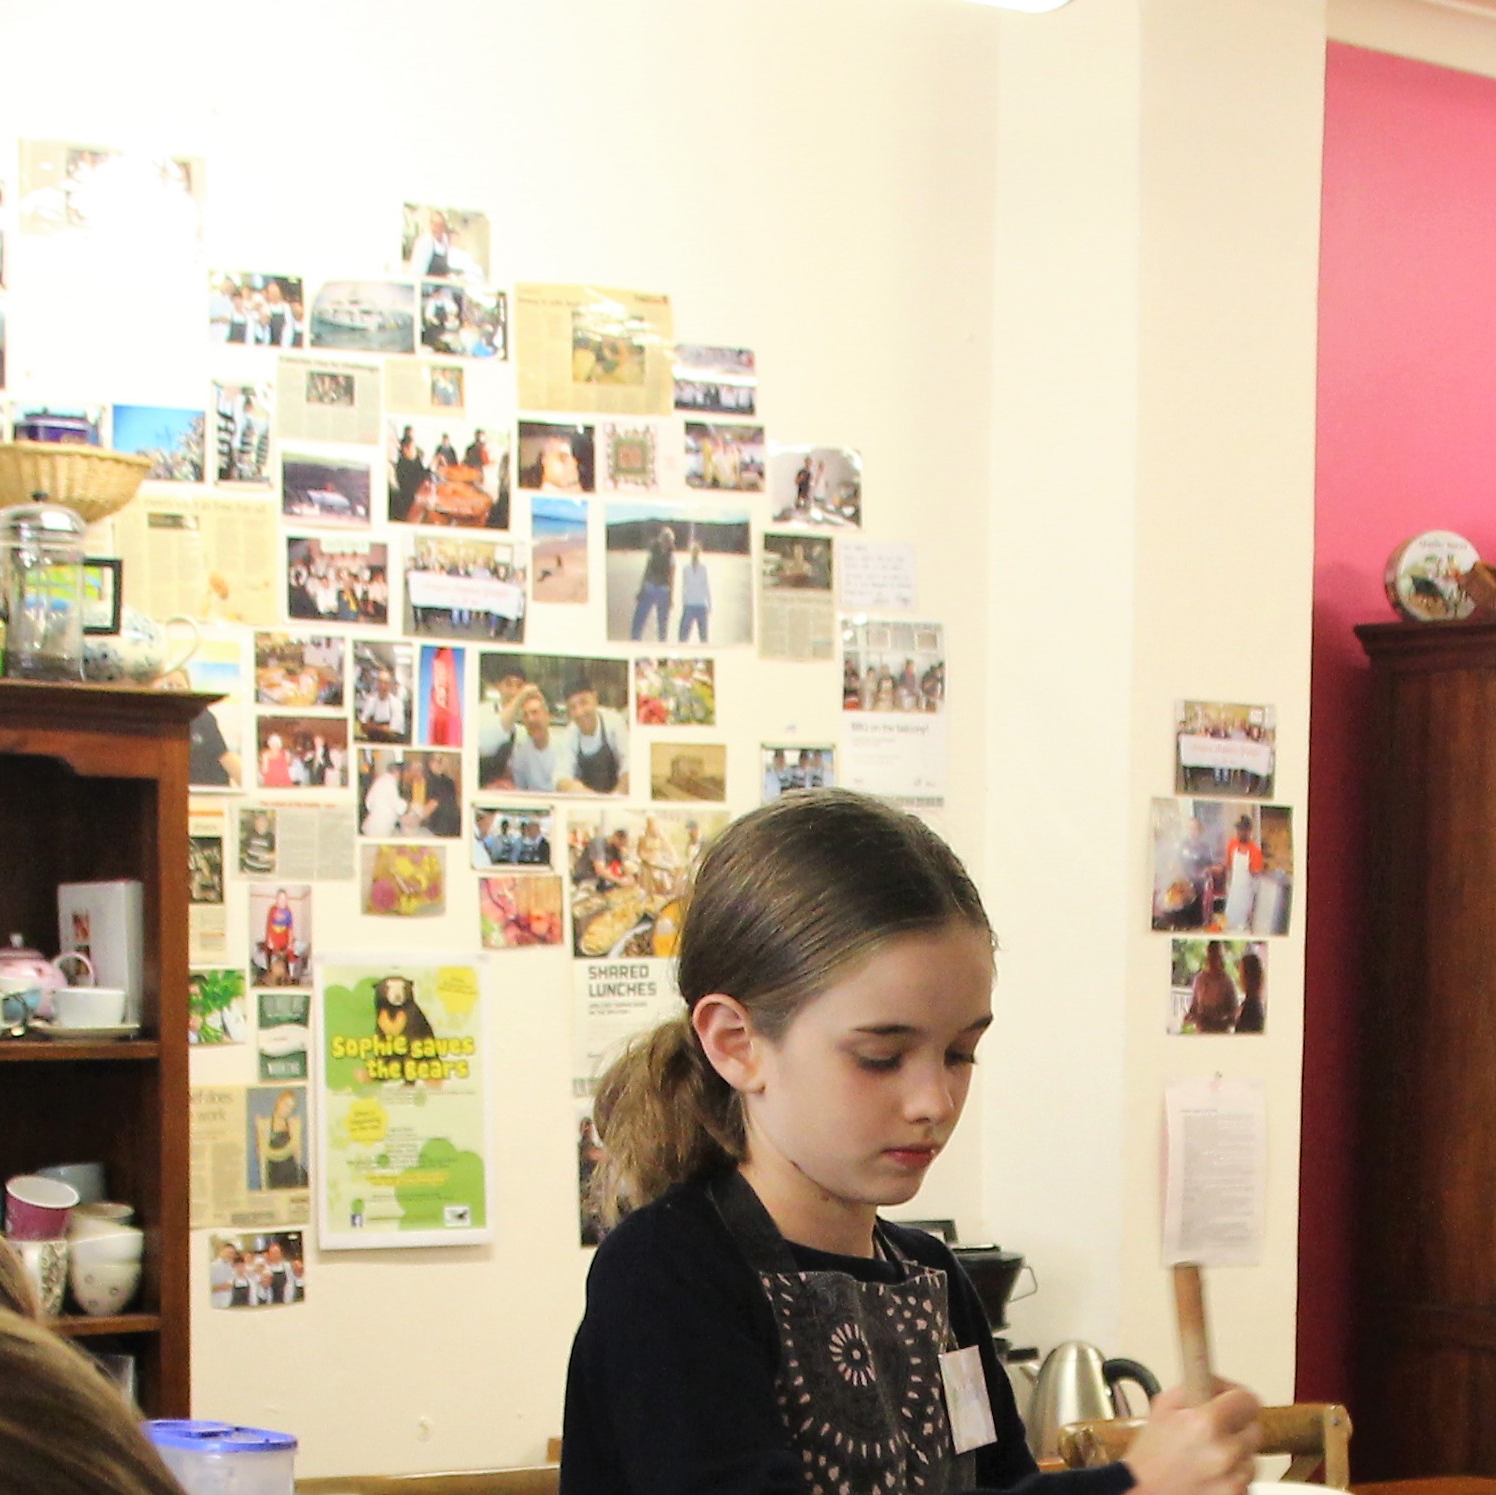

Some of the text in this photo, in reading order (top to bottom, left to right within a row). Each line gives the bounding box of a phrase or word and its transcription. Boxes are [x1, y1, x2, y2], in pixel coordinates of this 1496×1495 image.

[588, 965, 650, 980] SHARED
[588, 982, 657, 998] LUNCHES
[331, 1035, 476, 1059] Sophie saves
[366, 1058, 402, 1079] the
